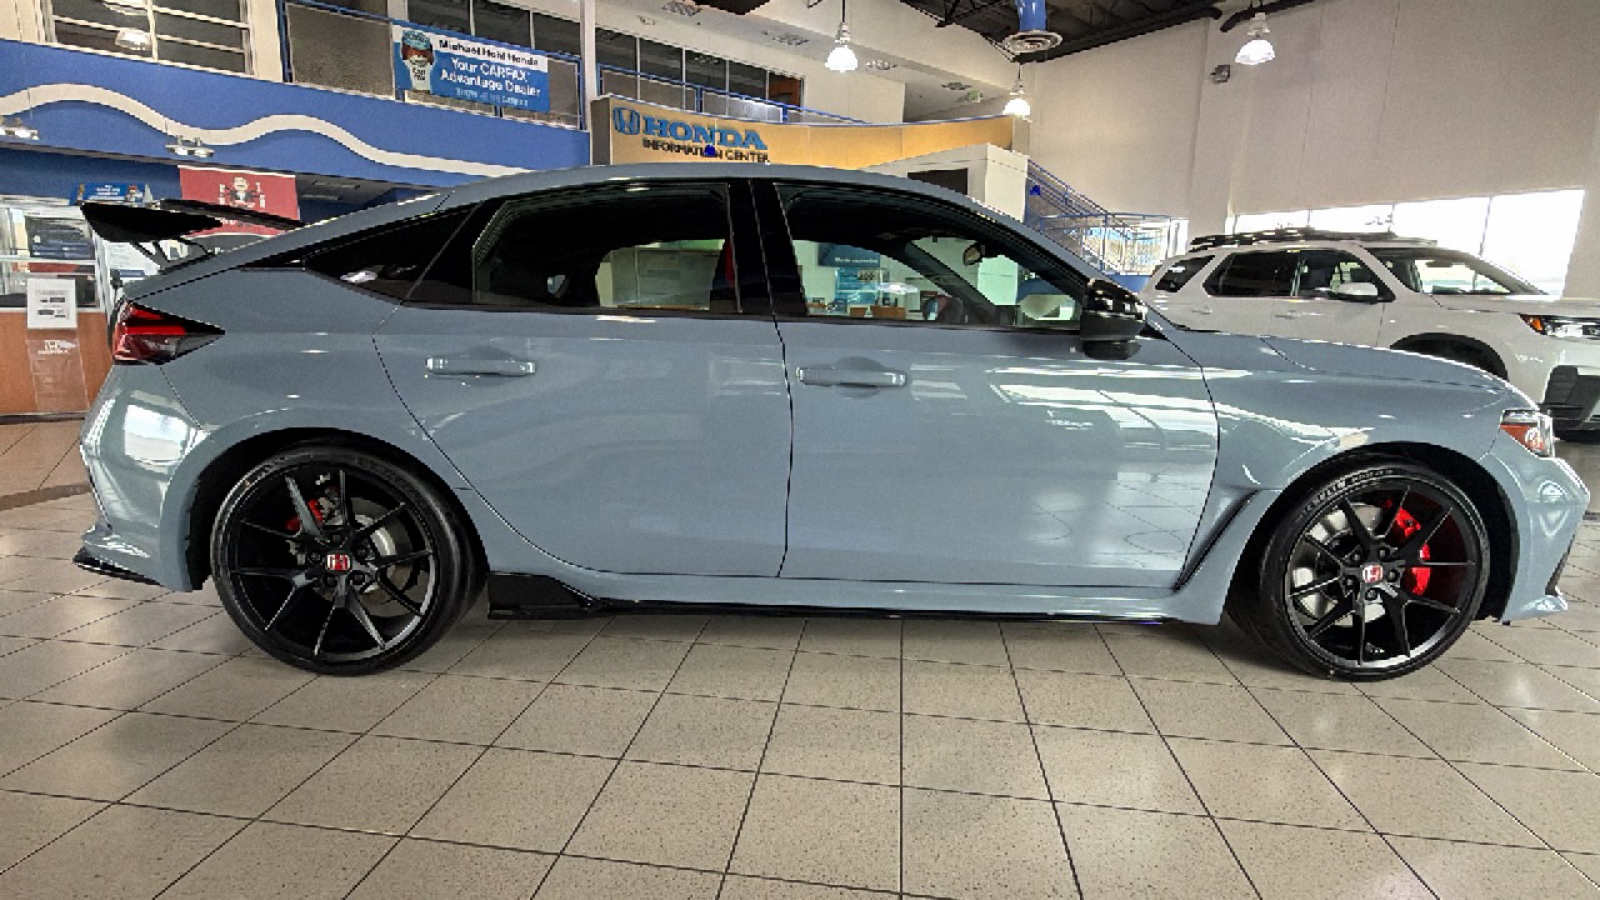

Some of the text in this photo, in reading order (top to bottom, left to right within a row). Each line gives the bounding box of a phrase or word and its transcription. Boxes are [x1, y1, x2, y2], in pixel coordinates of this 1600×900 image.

[451, 57, 528, 81] Your CARFAX
[507, 52, 539, 66] Honda
[440, 69, 541, 97] Advantage Dealer
[643, 116, 768, 150] HONDA
[643, 139, 771, 164] INFORMATIN CENTER
